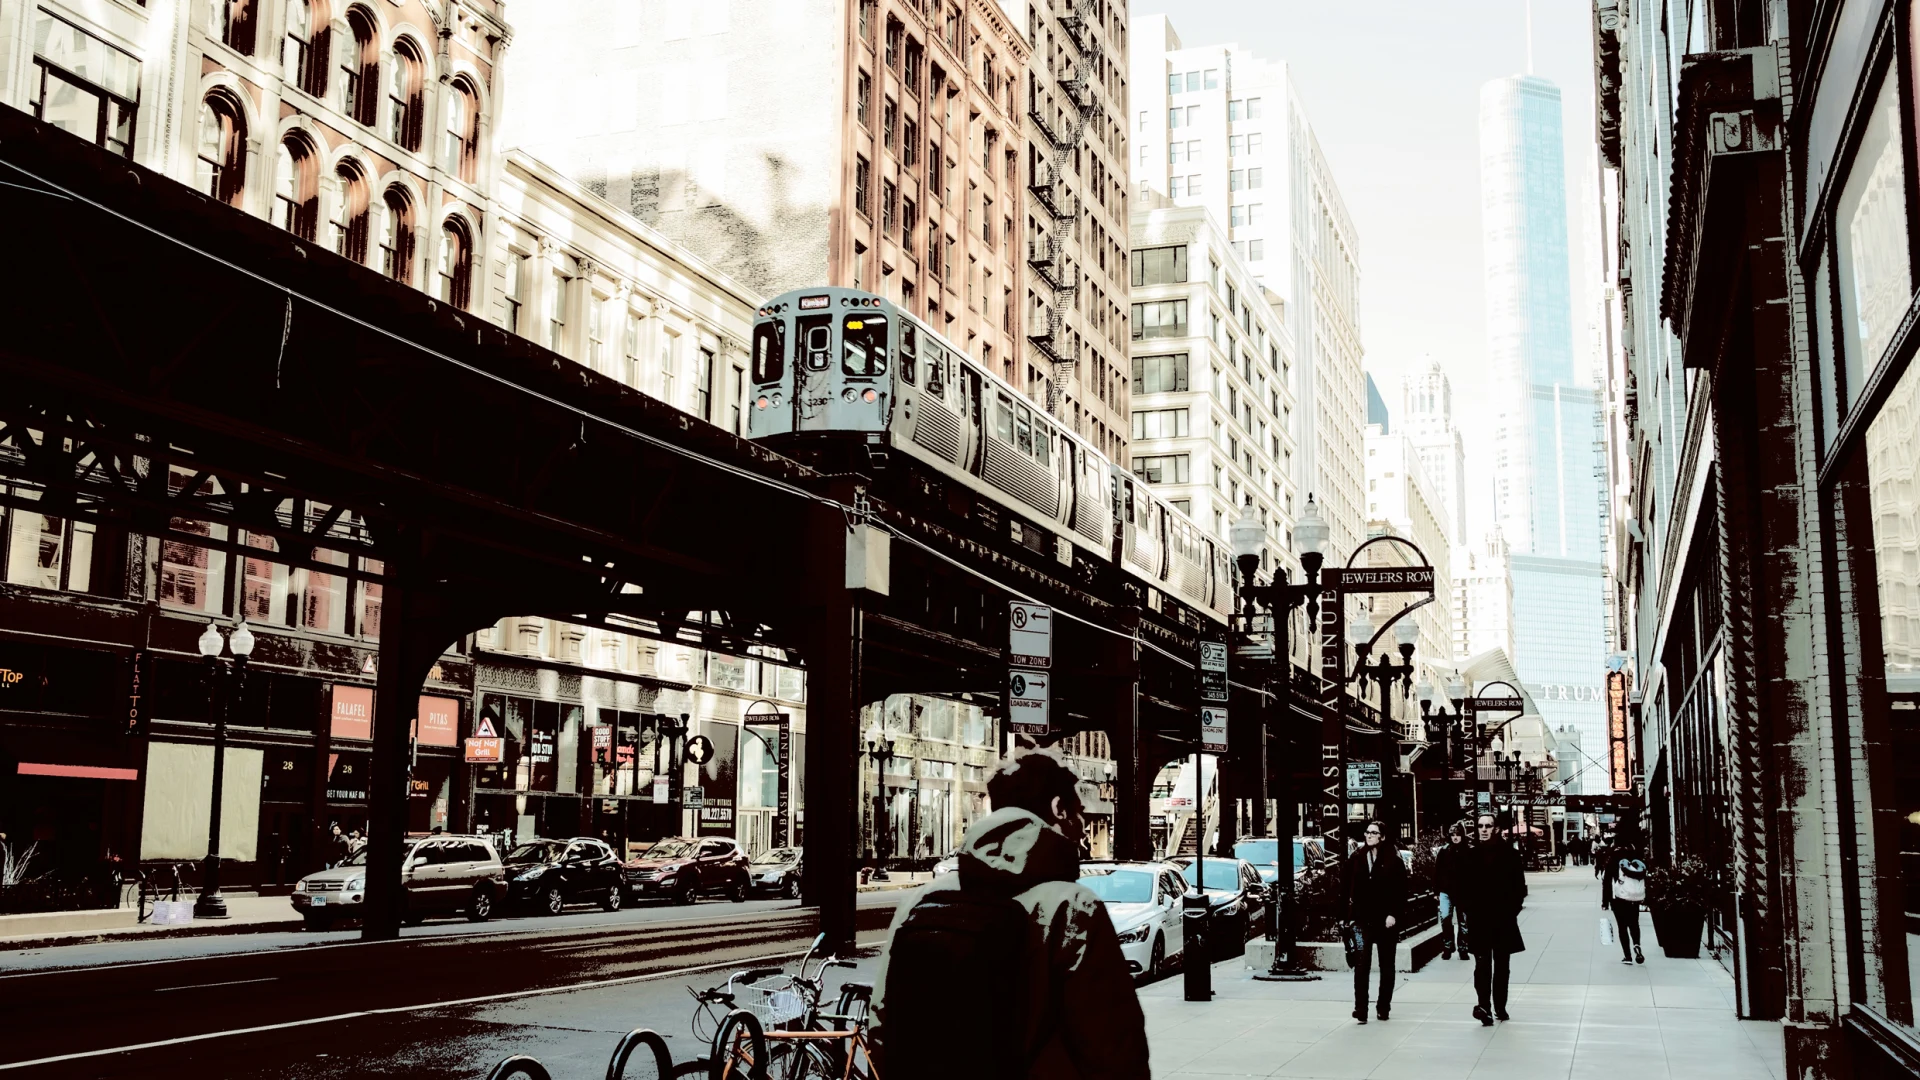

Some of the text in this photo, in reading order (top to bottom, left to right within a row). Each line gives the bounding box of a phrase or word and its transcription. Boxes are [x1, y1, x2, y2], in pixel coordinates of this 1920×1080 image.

[1341, 571, 1434, 584] JEWELERS ROW
[1013, 654, 1046, 666] TOW ZONE
[0, 668, 24, 684] TOP
[1541, 685, 1605, 702] TRUM
[336, 701, 366, 717] FALAFEL
[1010, 700, 1030, 708] LOADING
[429, 711, 449, 725] PITAS
[594, 727, 610, 736] GOOD
[1027, 724, 1044, 734] ZONE
[1320, 589, 1340, 868] WABASH AVENUE
[468, 739, 498, 749] Naf Naf
[594, 735, 611, 743] STUFF
[1463, 708, 1474, 773] AVENUE
[474, 748, 491, 756] Grill
[282, 760, 294, 771] 28
[342, 764, 353, 774] 28
[778, 722, 789, 849] WABASH AVENUE
[326, 789, 366, 799] GET YOUR NAF ON
